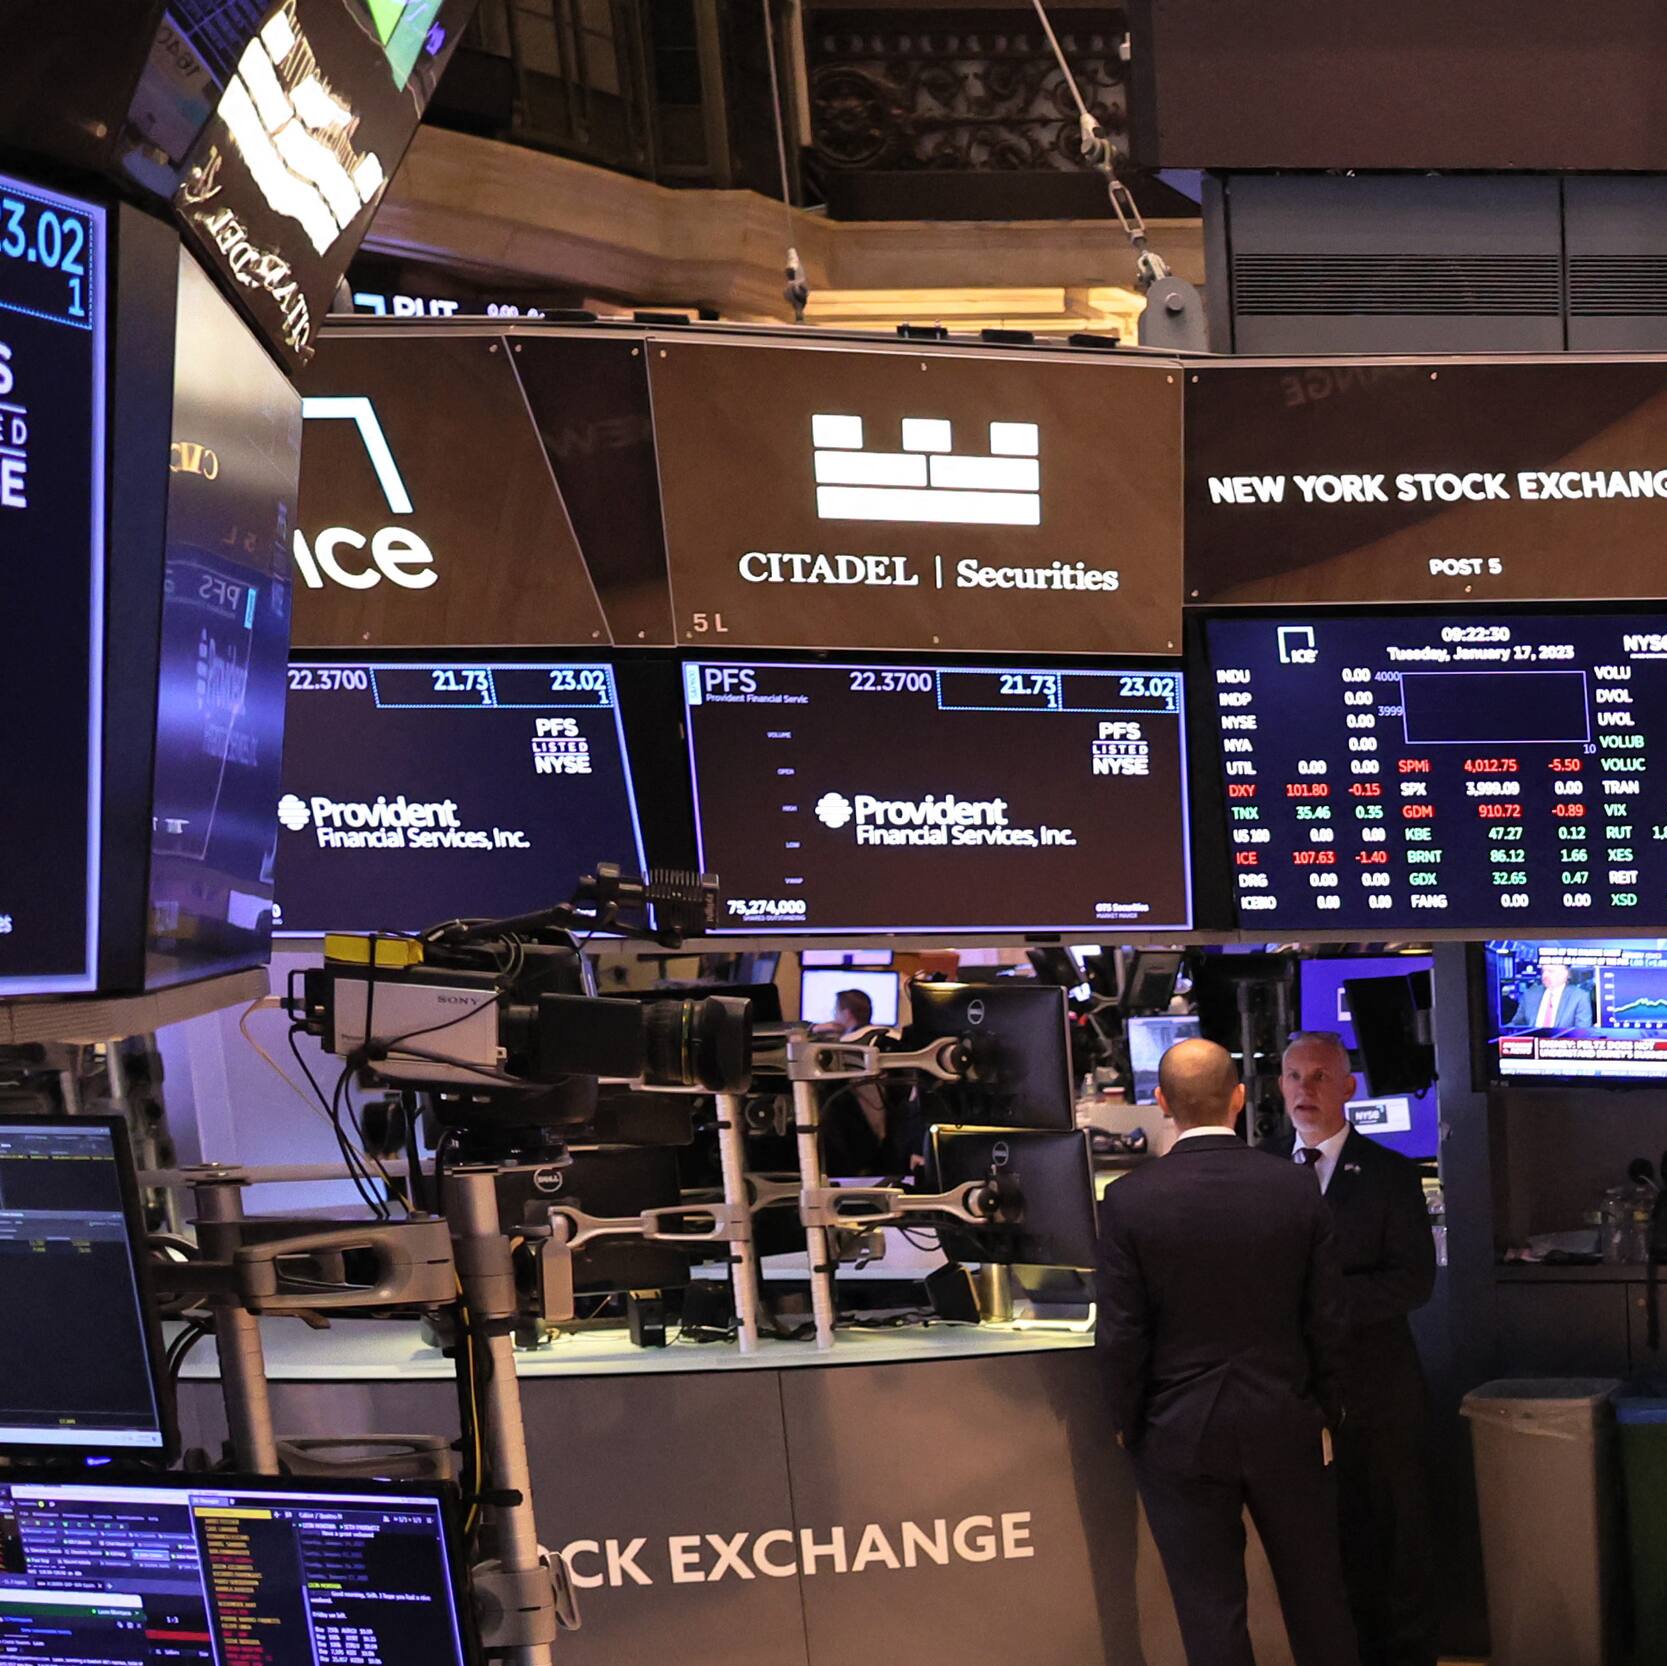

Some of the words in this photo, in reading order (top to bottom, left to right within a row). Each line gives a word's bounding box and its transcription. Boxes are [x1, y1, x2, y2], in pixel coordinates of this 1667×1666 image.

[0, 199, 84, 275] 3.02
[1208, 476, 1285, 503] NEW
[1293, 475, 1388, 502] YORK
[1396, 473, 1510, 501] STOCK
[739, 552, 918, 585] CITADEL
[957, 559, 1119, 590] Securities
[1429, 559, 1478, 575] POST
[1488, 558, 1502, 574] 5
[1386, 646, 1451, 662] Tuesday,
[1453, 645, 1511, 662] January
[1513, 645, 1537, 661] 17,
[1538, 644, 1575, 659] 2023
[288, 670, 367, 689] 22.3700
[431, 670, 489, 692] 21.73
[549, 670, 606, 692] 23.02
[705, 669, 756, 692] PFS
[850, 672, 932, 691] 22.3700
[999, 674, 1057, 695] 21.73
[1119, 677, 1175, 697] 23.02
[536, 718, 578, 736] PFS
[1098, 721, 1142, 740] PFS
[531, 741, 589, 752] LISTED
[1092, 744, 1149, 755] LISTED
[1600, 735, 1645, 748] VOLUB
[534, 756, 592, 774] NYSE
[1092, 758, 1150, 775] NYSE
[1464, 758, 1518, 773] 4,012.75
[1548, 758, 1580, 771] -5.50
[1601, 757, 1646, 771] VOLUC
[310, 795, 461, 828] Provident
[854, 794, 1008, 825] Provident
[1231, 806, 1260, 820] TNX
[1296, 806, 1332, 820] 35.46
[1355, 804, 1384, 819] 0.35
[1402, 805, 1434, 818] GDM
[1478, 805, 1521, 818] 910.72
[1552, 804, 1584, 818] -0.89
[1604, 803, 1627, 817] VIX
[317, 827, 405, 848] Financial
[408, 828, 493, 851] Services,
[494, 828, 531, 848] Inc.
[856, 825, 948, 845] Financial
[951, 825, 1039, 848] Services,
[1040, 826, 1077, 846] Inc.
[727, 899, 807, 915] 75,274,000
[1611, 893, 1638, 906] XSD
[669, 1512, 1034, 1583] EXCHANGE
